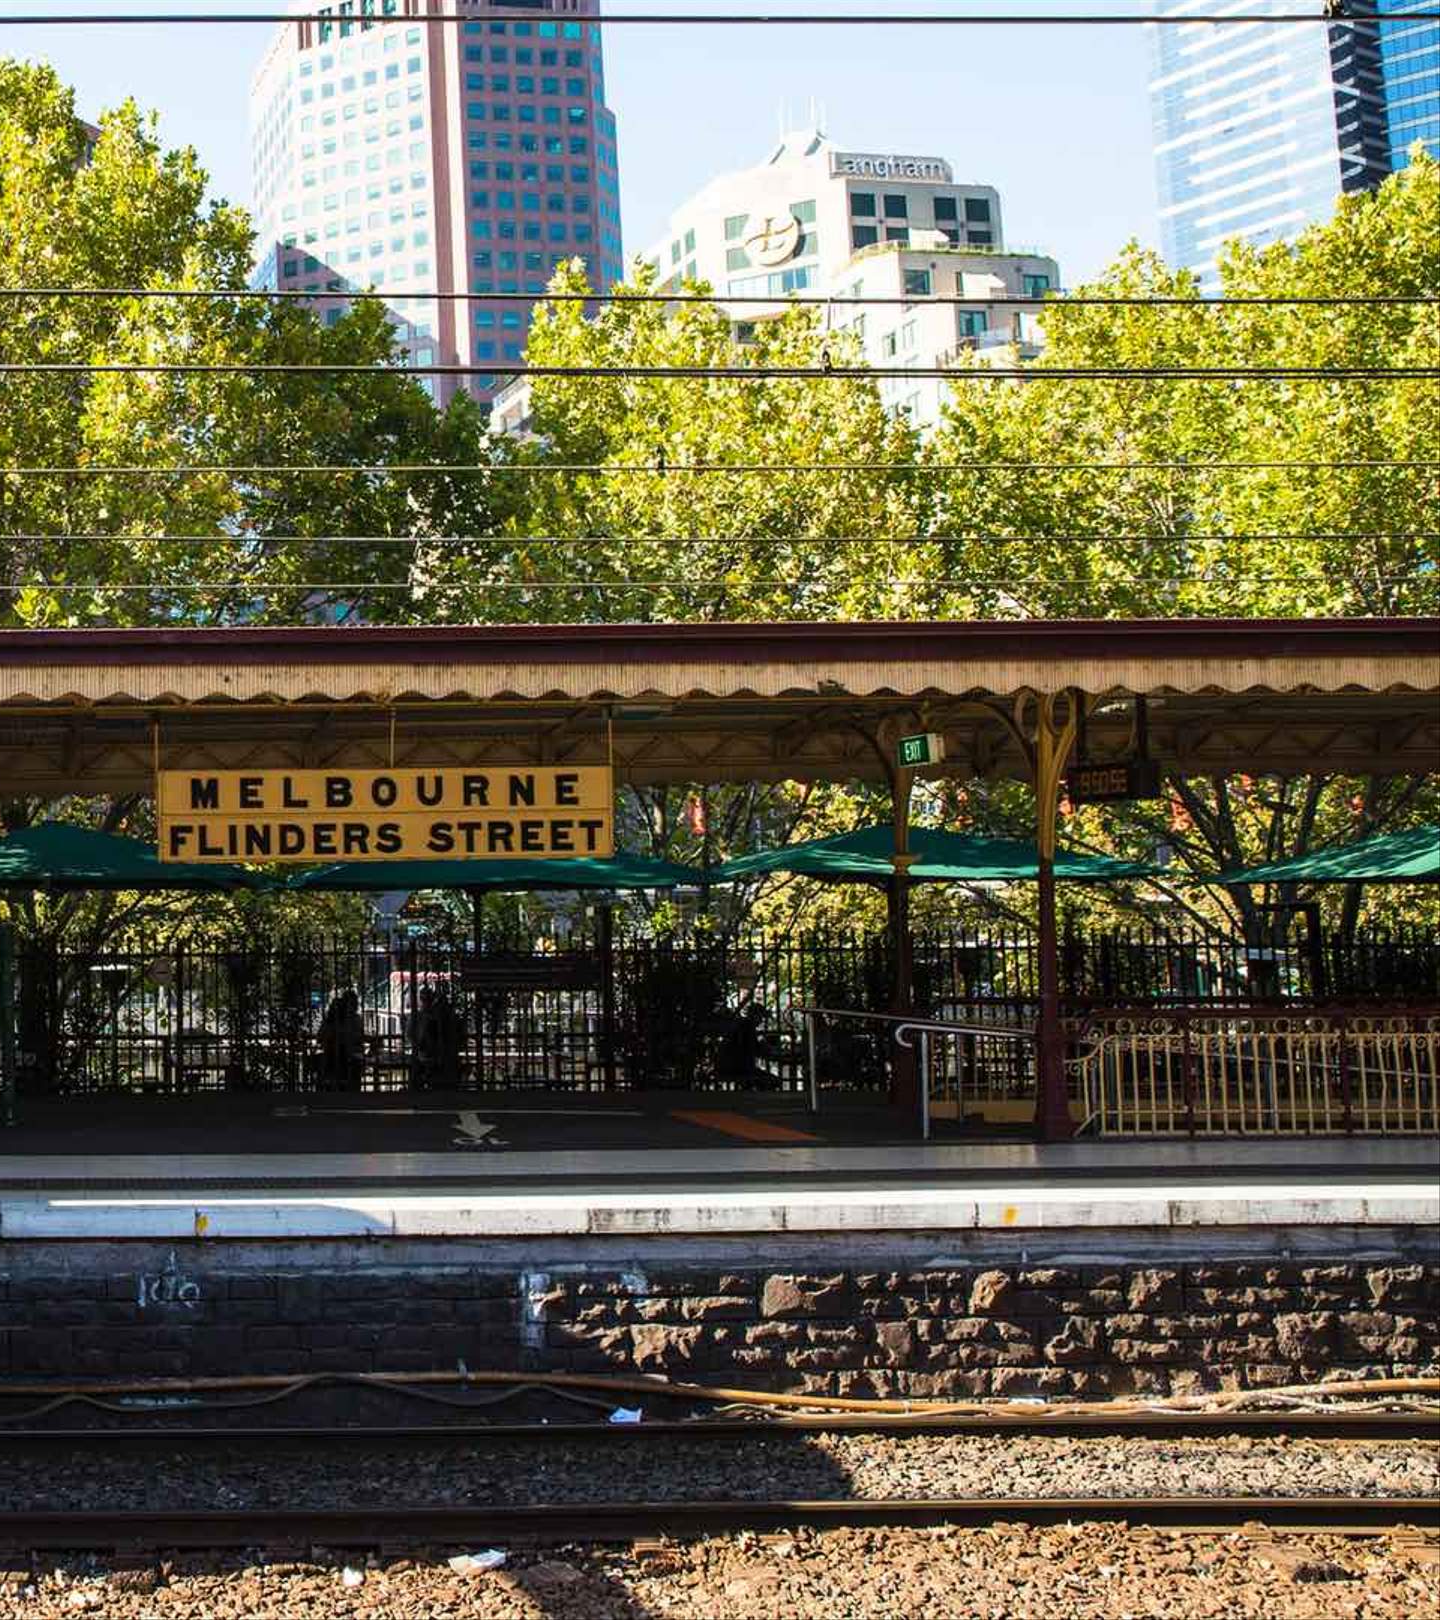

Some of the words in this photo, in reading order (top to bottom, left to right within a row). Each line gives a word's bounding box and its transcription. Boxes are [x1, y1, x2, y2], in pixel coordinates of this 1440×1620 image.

[833, 153, 944, 179] Langham
[904, 741, 921, 761] EXIT
[190, 773, 580, 810] MELBOURNE
[169, 822, 403, 857] FLINDERS
[426, 819, 604, 853] STREET
